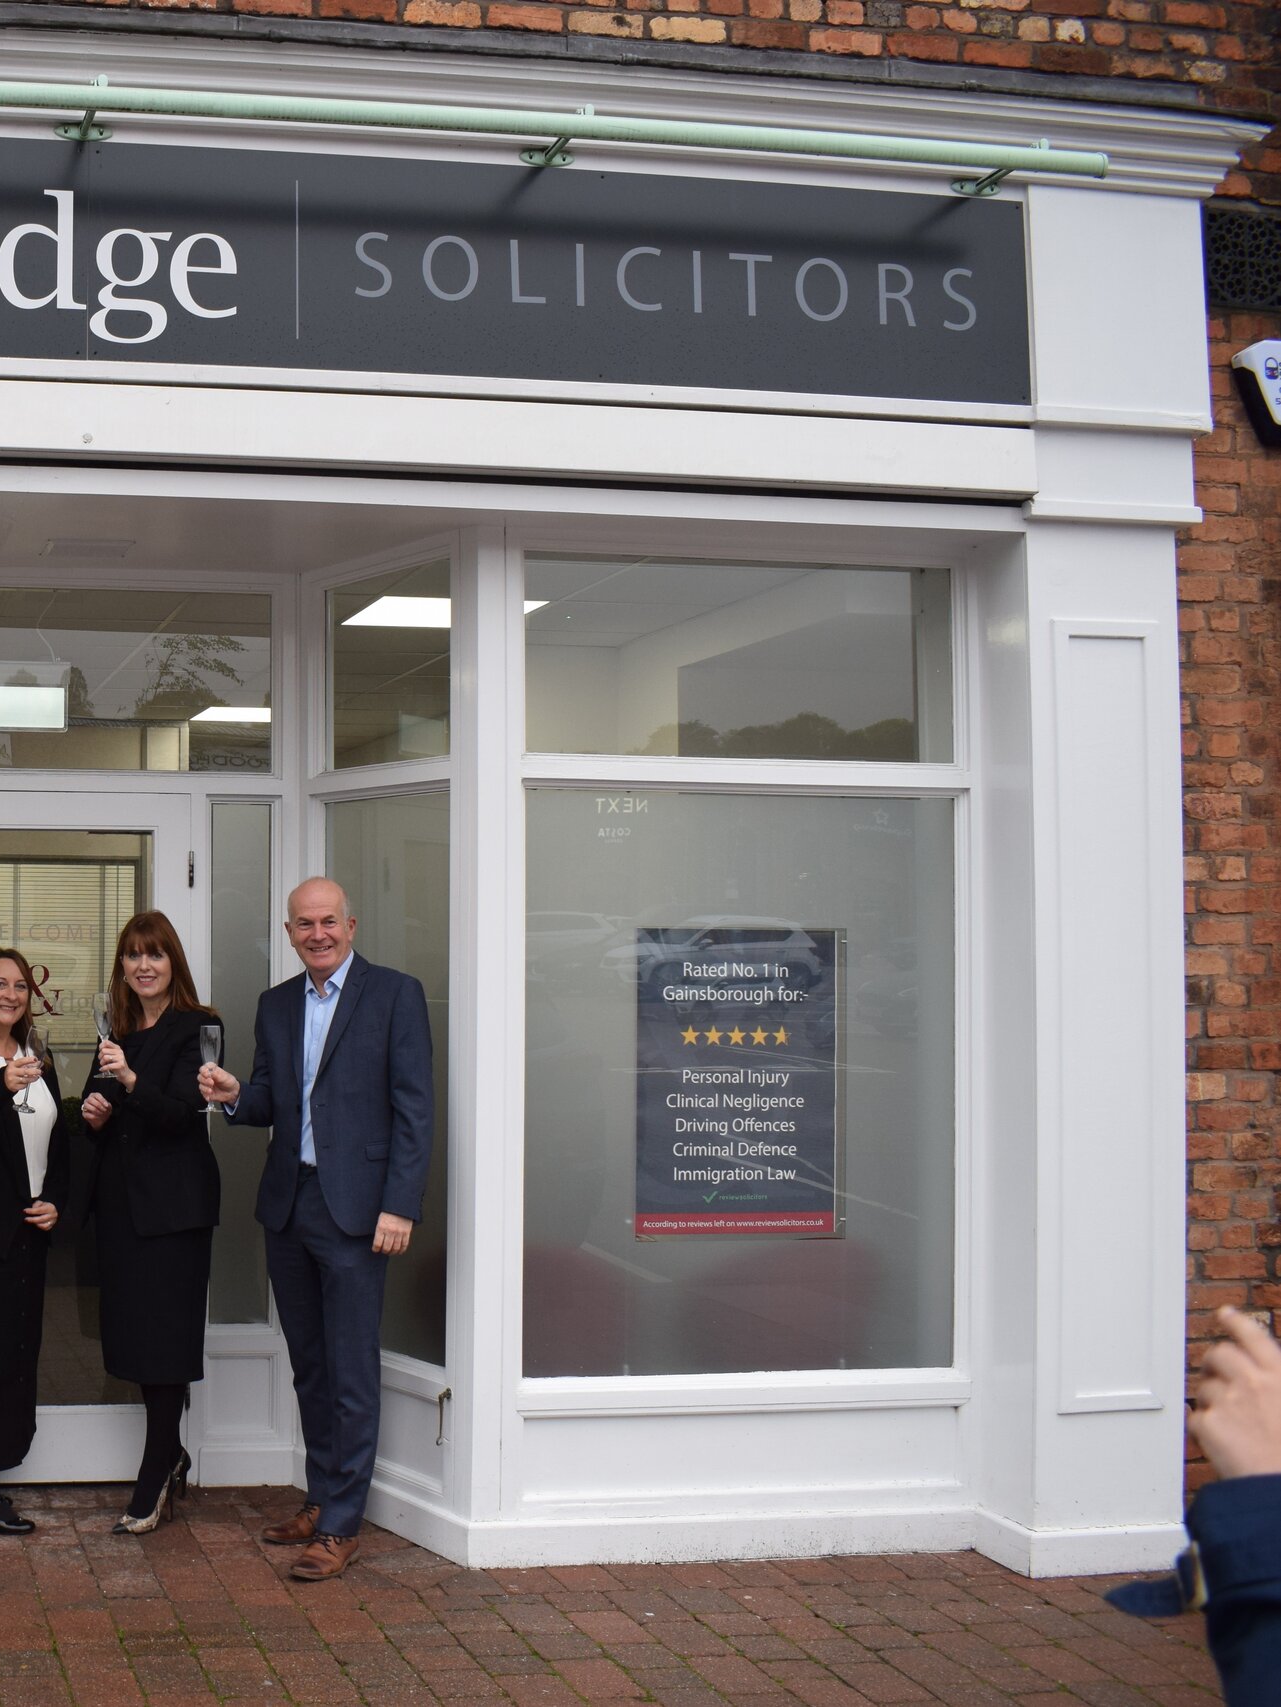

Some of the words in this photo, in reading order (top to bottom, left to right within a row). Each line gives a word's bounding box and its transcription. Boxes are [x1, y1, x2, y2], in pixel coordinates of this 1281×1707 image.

[354, 231, 977, 332] SOLICITORS
[682, 961, 728, 978] Rated
[732, 962, 758, 978] No.
[762, 963, 769, 978] 1
[775, 963, 790, 978] in
[662, 985, 774, 1005] Gainsborough
[776, 985, 810, 1003] for:-
[681, 1069, 744, 1085] Personal
[747, 1069, 790, 1089] Injury
[665, 1093, 719, 1109] Clinical
[722, 1093, 805, 1113] Negligence
[674, 1118, 728, 1137] Driving
[732, 1117, 796, 1133] Offences
[672, 1142, 734, 1158] Criminal
[738, 1142, 798, 1158] Defence
[673, 1166, 764, 1185] Immigration
[767, 1166, 797, 1181] Law
[718, 1193, 769, 1201] reviewsolicitors
[643, 1220, 678, 1230] According
[687, 1220, 713, 1228] reviews
[714, 1219, 725, 1228] left
[736, 1218, 825, 1228] www.reviewsolicitors.co.uk
